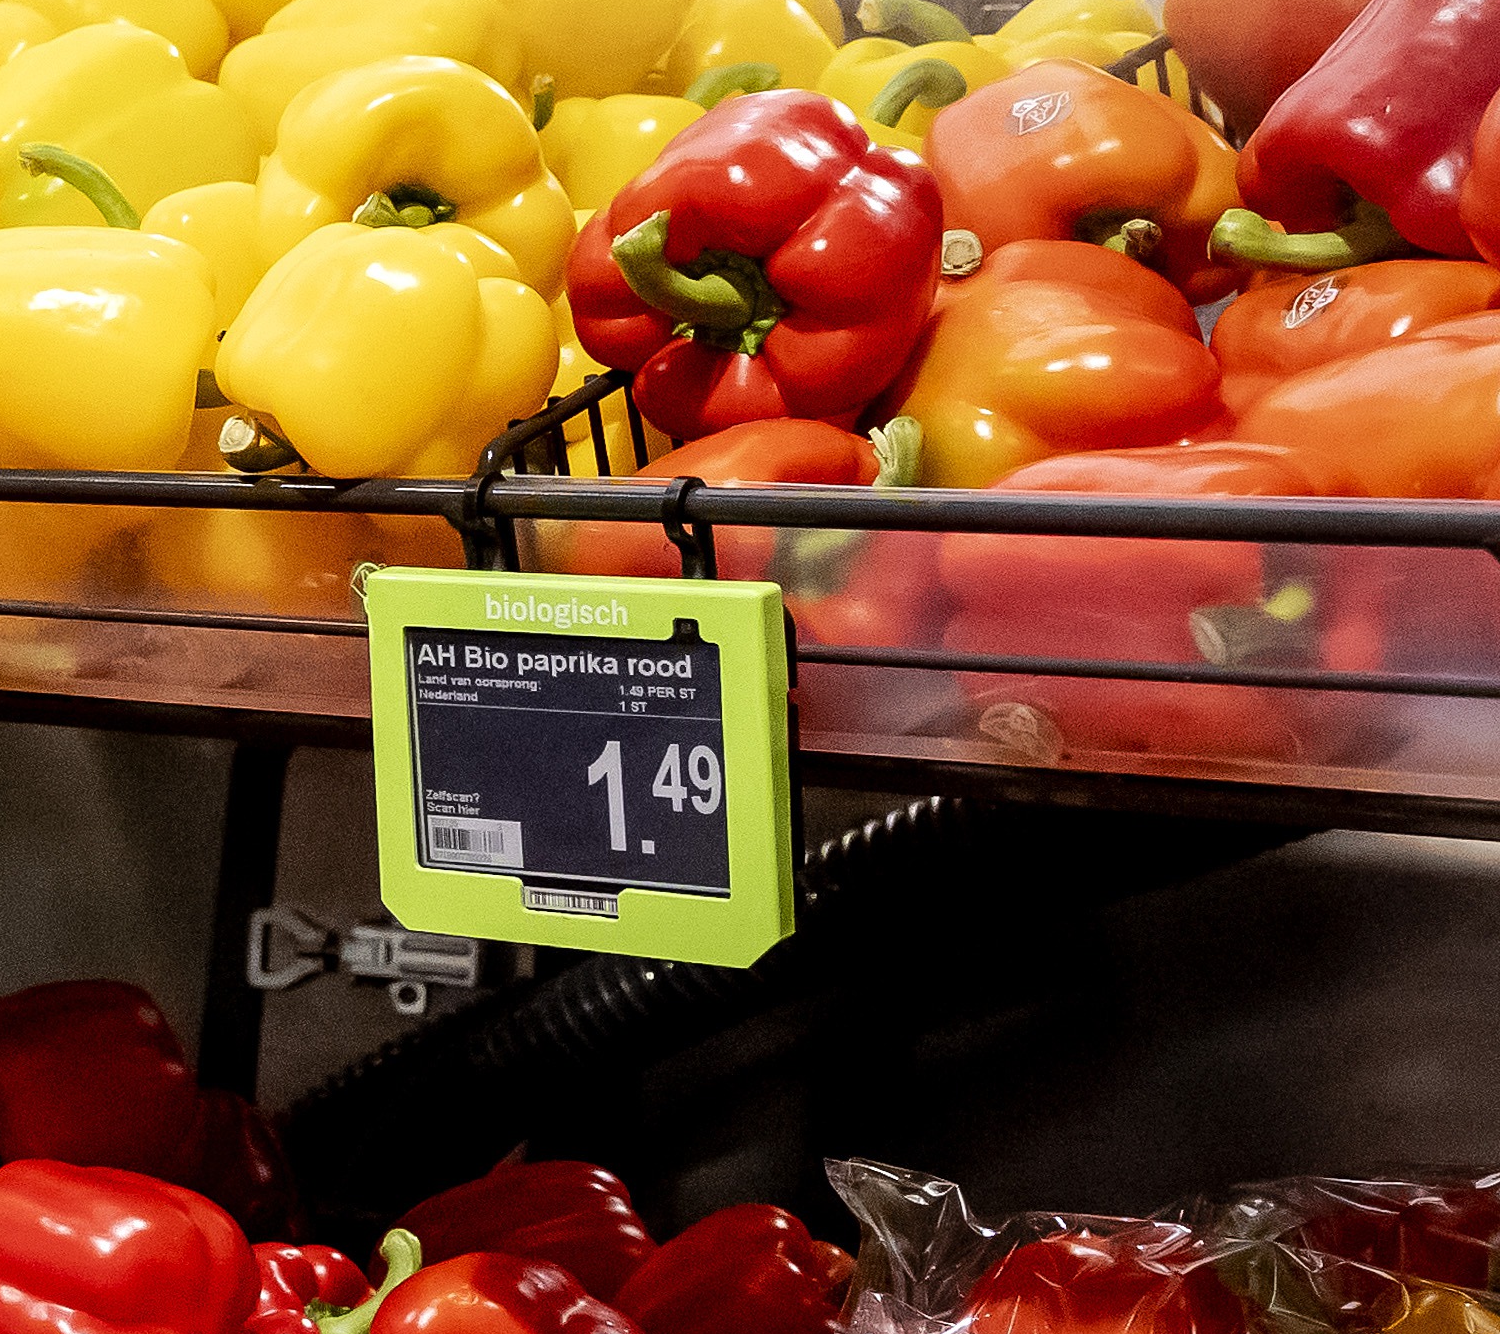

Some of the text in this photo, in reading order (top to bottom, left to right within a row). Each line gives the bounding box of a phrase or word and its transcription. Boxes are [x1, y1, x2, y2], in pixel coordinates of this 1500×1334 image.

[485, 593, 628, 629] biologisch
[418, 643, 692, 679] AH Bio paprika rood
[418, 673, 447, 686] Land
[451, 677, 472, 687] van
[419, 689, 479, 702] Nederland
[647, 686, 676, 699] PER
[679, 688, 697, 700] ST
[619, 701, 648, 713] 1 ST
[588, 740, 722, 854] 1.49
[426, 801, 455, 814] Scan
